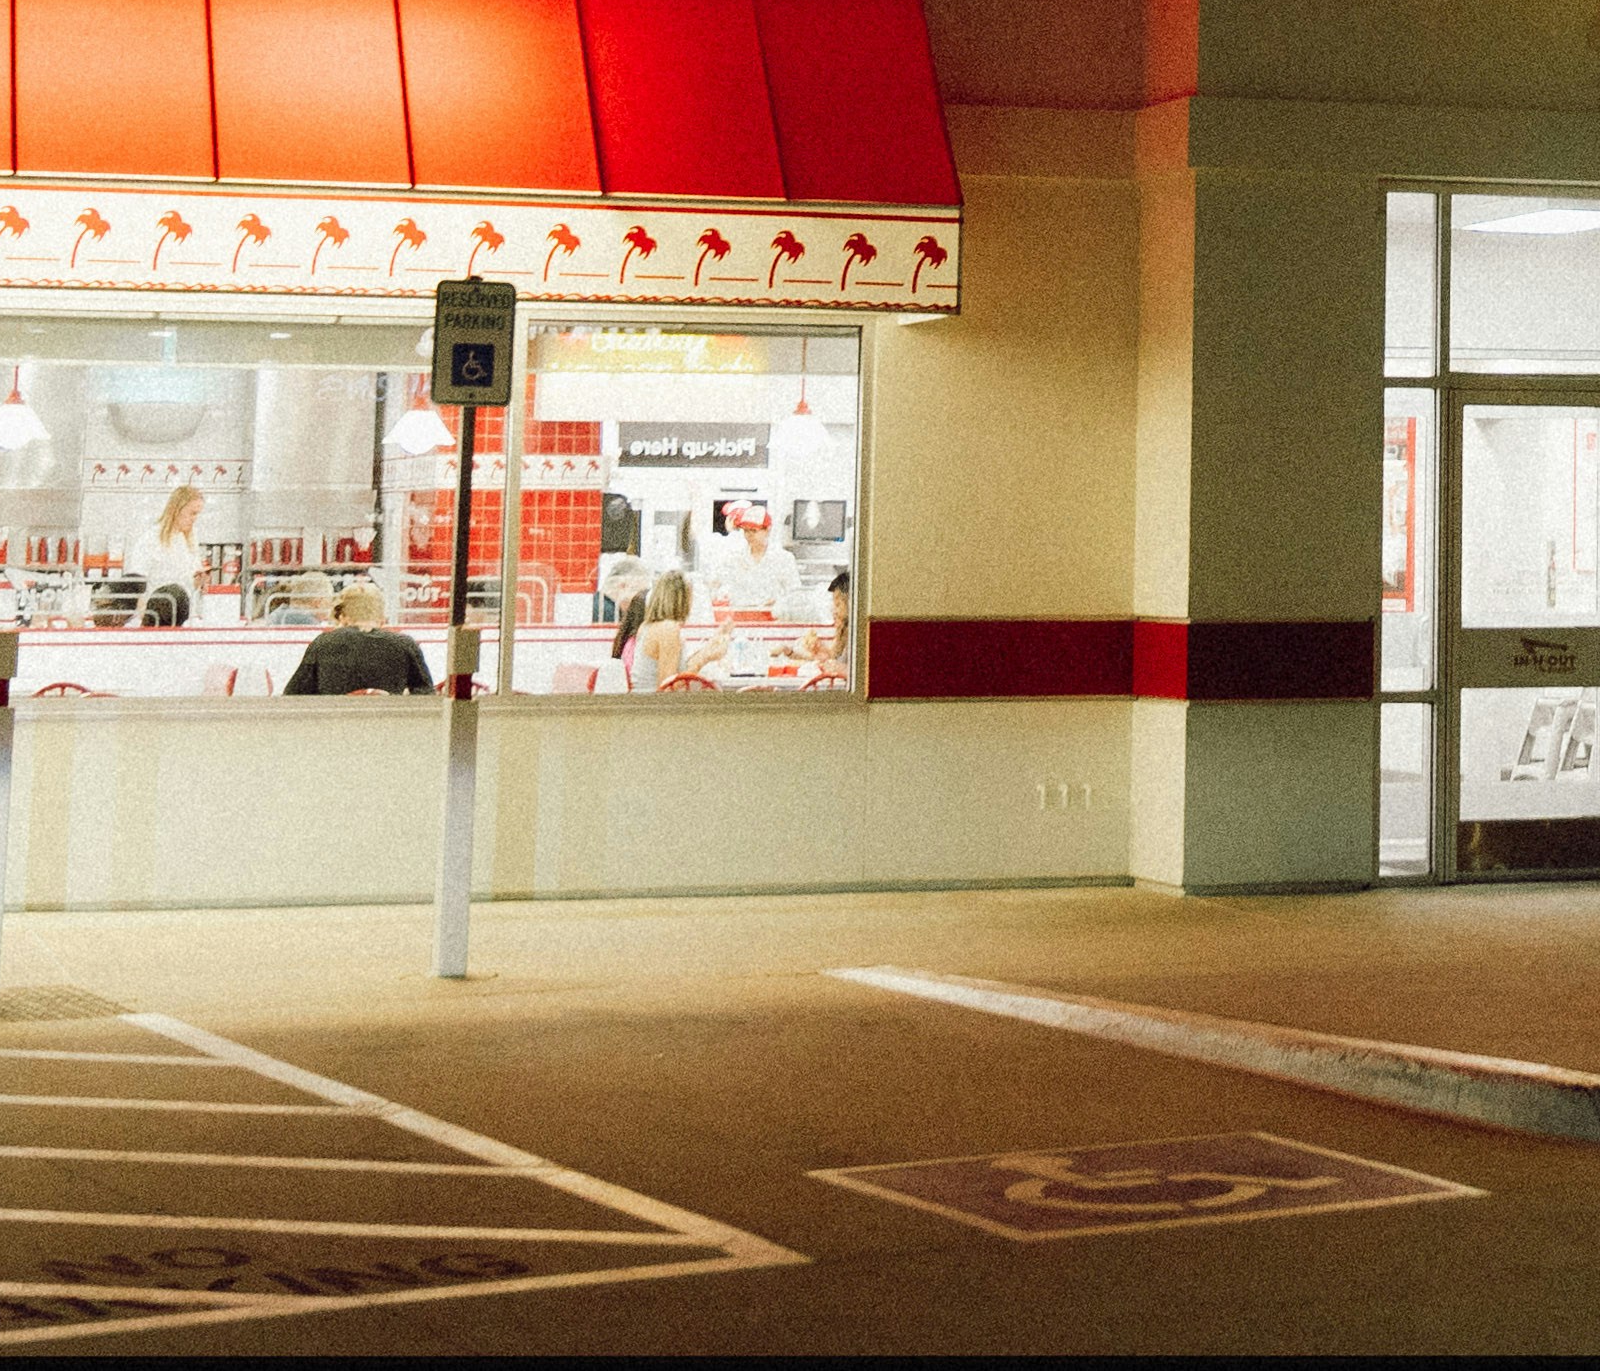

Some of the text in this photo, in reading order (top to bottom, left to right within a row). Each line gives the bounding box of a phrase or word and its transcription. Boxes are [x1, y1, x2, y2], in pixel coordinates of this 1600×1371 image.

[441, 291, 512, 309] RESERVED
[444, 313, 504, 330] PARKING
[39, 1245, 252, 1284] NO
